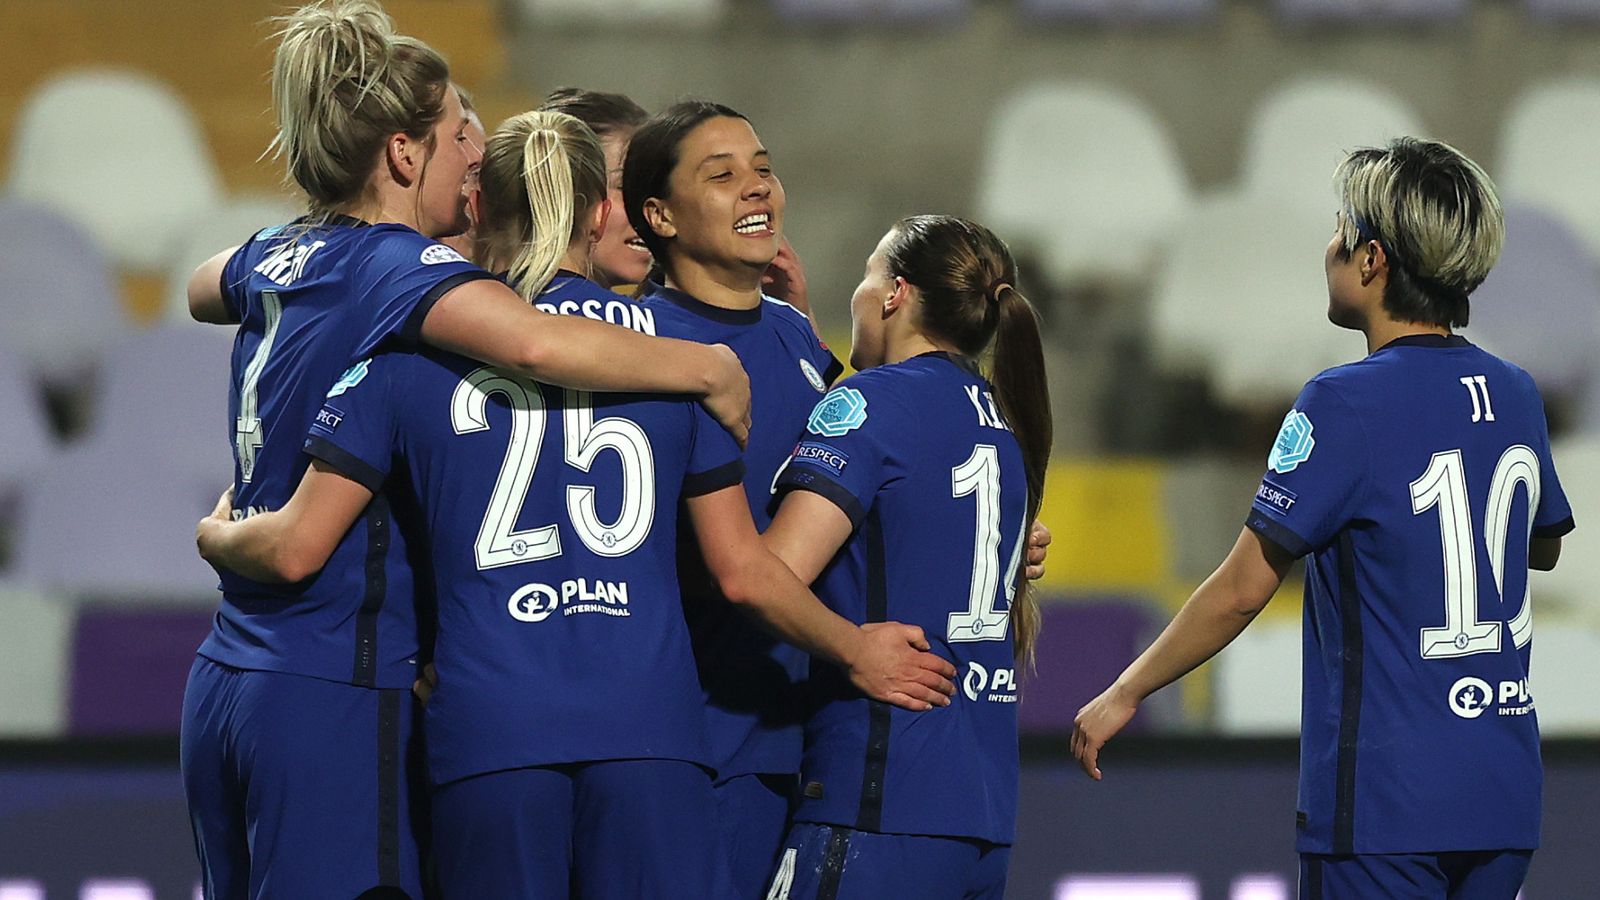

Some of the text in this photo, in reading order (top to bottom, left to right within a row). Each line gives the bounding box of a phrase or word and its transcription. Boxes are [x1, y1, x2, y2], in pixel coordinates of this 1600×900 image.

[536, 300, 656, 336] SON
[1460, 375, 1495, 422] JI
[451, 365, 655, 570] 25
[797, 447, 847, 470] RESPECT
[1257, 485, 1295, 509] RESPECT
[1410, 444, 1541, 659] 10
[561, 577, 628, 605] PLAN
[564, 604, 631, 616] INTERNATIONAL
